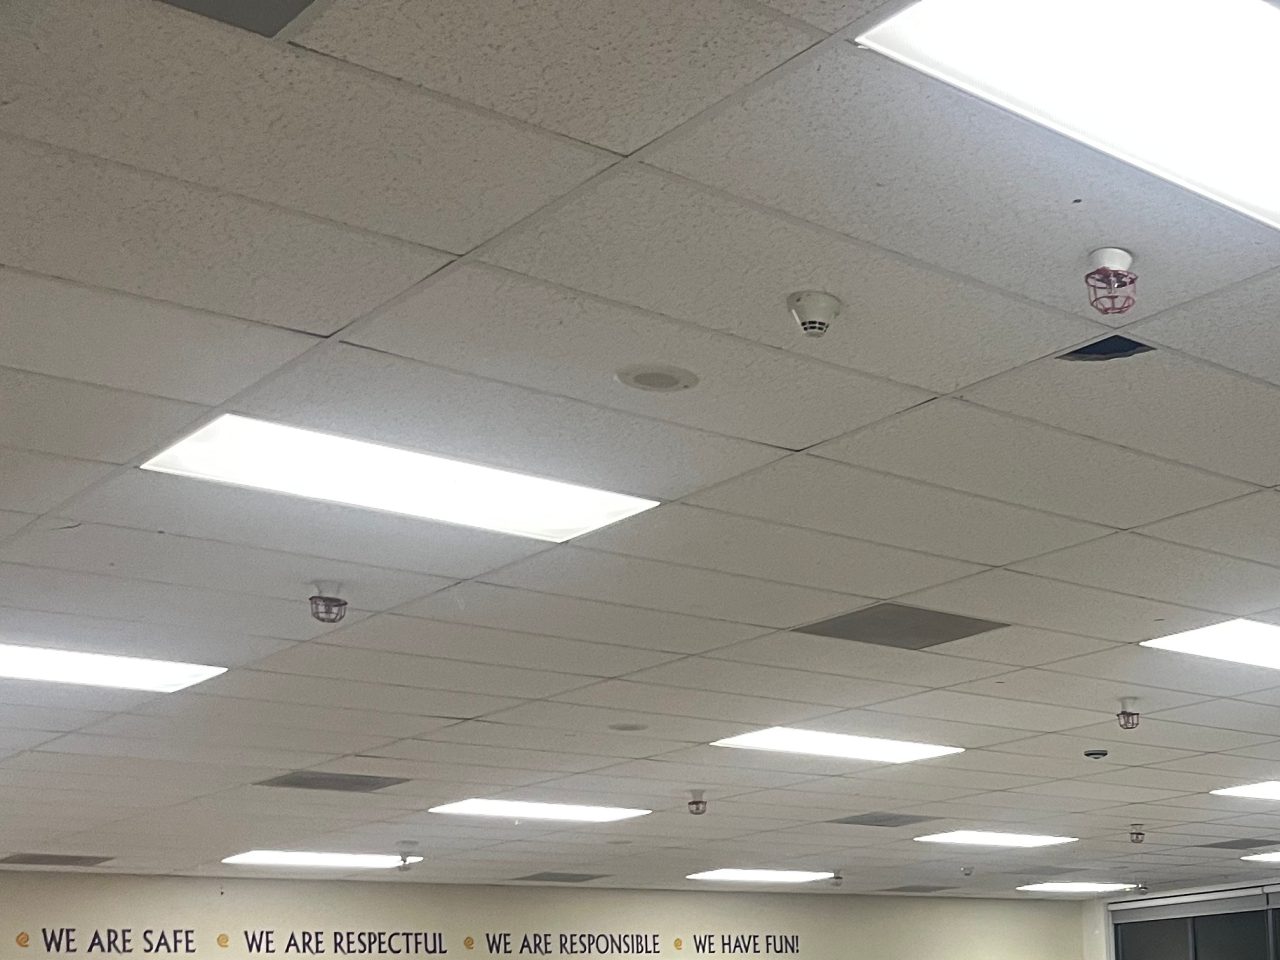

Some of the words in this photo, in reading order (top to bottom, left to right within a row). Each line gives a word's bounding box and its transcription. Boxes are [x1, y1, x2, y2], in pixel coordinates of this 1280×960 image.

[42, 928, 77, 954] WE
[88, 929, 133, 954] ARE
[143, 929, 197, 953] SAFE
[244, 930, 276, 954] WE
[285, 931, 325, 955] ARE
[333, 931, 448, 955] RESPECTFUL
[486, 933, 512, 954] WE
[519, 933, 552, 955] ARE
[559, 934, 660, 955] RESPONSIBLE
[693, 934, 716, 953] WE
[721, 934, 761, 954] HAVE
[766, 935, 799, 953] FUN!
